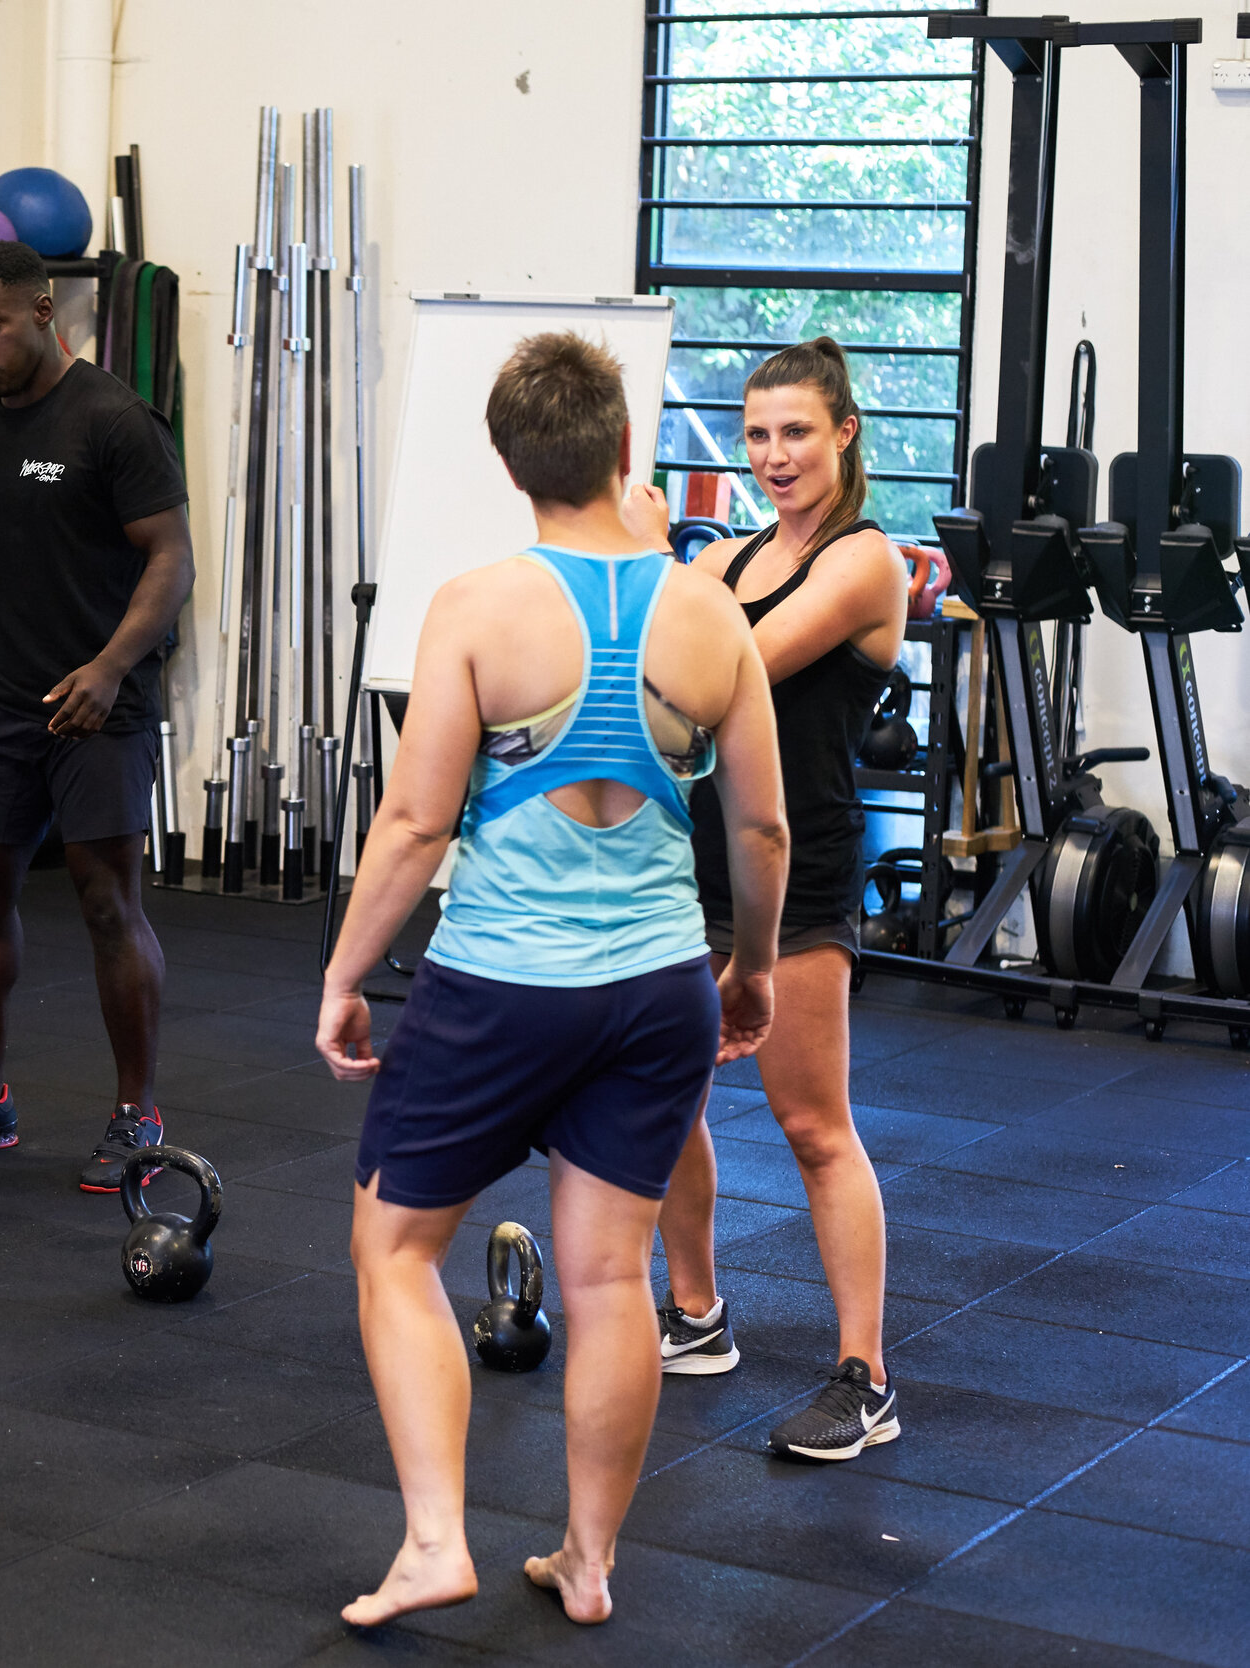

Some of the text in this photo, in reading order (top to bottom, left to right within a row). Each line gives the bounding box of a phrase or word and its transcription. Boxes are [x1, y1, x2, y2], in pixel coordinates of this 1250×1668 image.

[1034, 667, 1058, 790] concept 2
[1185, 679, 1207, 786] concept
[134, 1259, 148, 1272] 16
